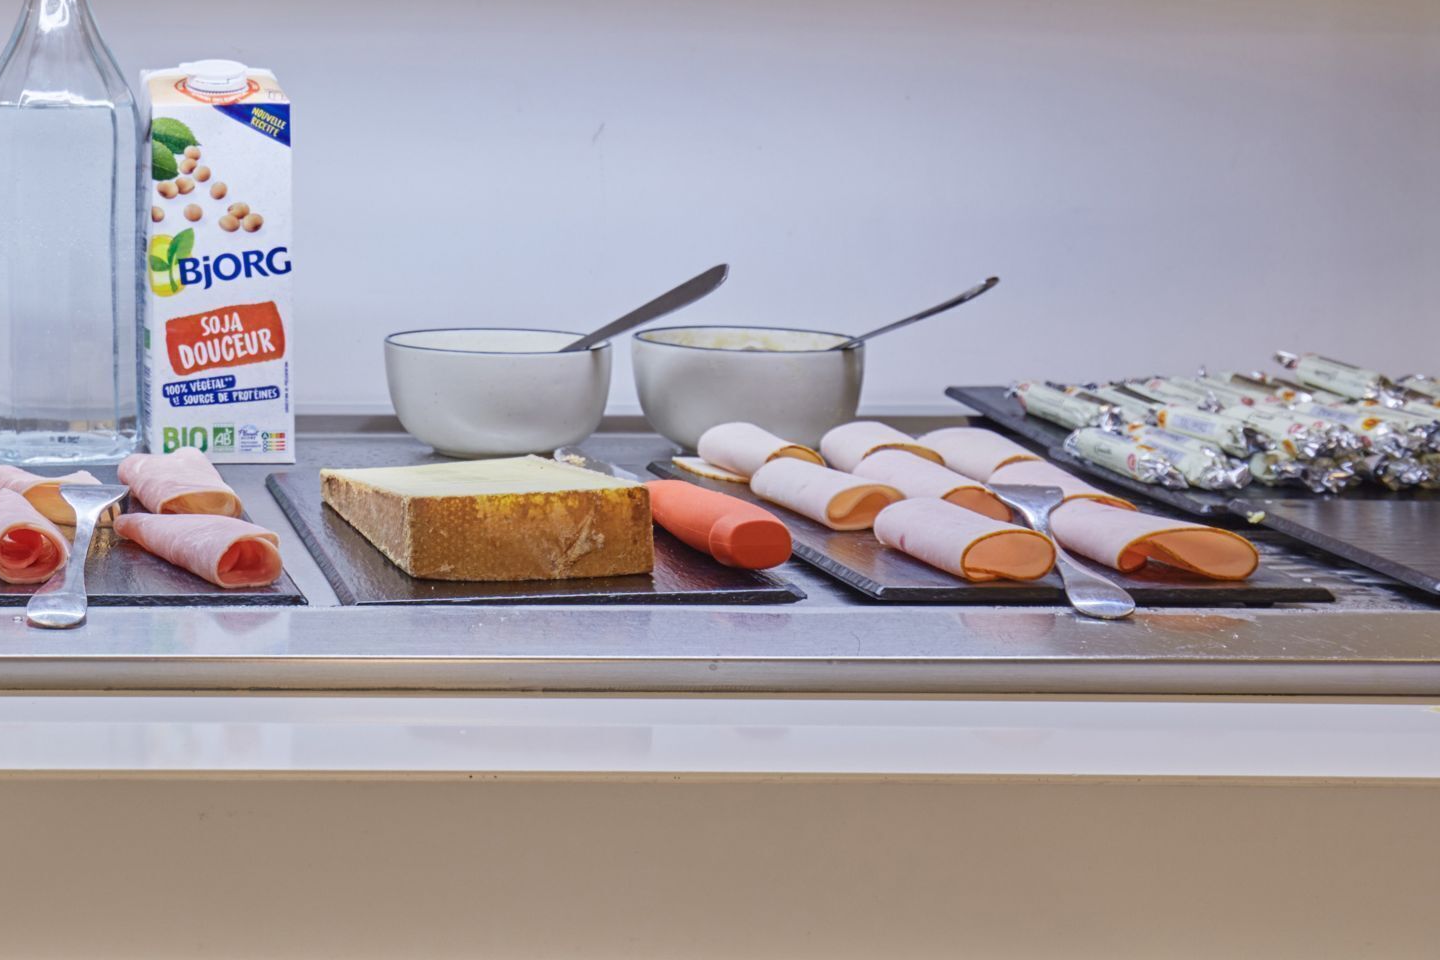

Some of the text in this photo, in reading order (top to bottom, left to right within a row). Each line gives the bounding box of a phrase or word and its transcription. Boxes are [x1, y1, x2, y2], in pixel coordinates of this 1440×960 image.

[250, 118, 280, 137] RECETTE
[251, 107, 287, 130] NOUVELLE
[200, 312, 243, 336] SOJA
[178, 328, 276, 369] DOUCEUR
[165, 383, 188, 396] 100%
[183, 394, 215, 405] SOURCE
[218, 392, 229, 403] DE
[232, 388, 278, 401] PROTÉINES
[163, 426, 208, 454] BIO
